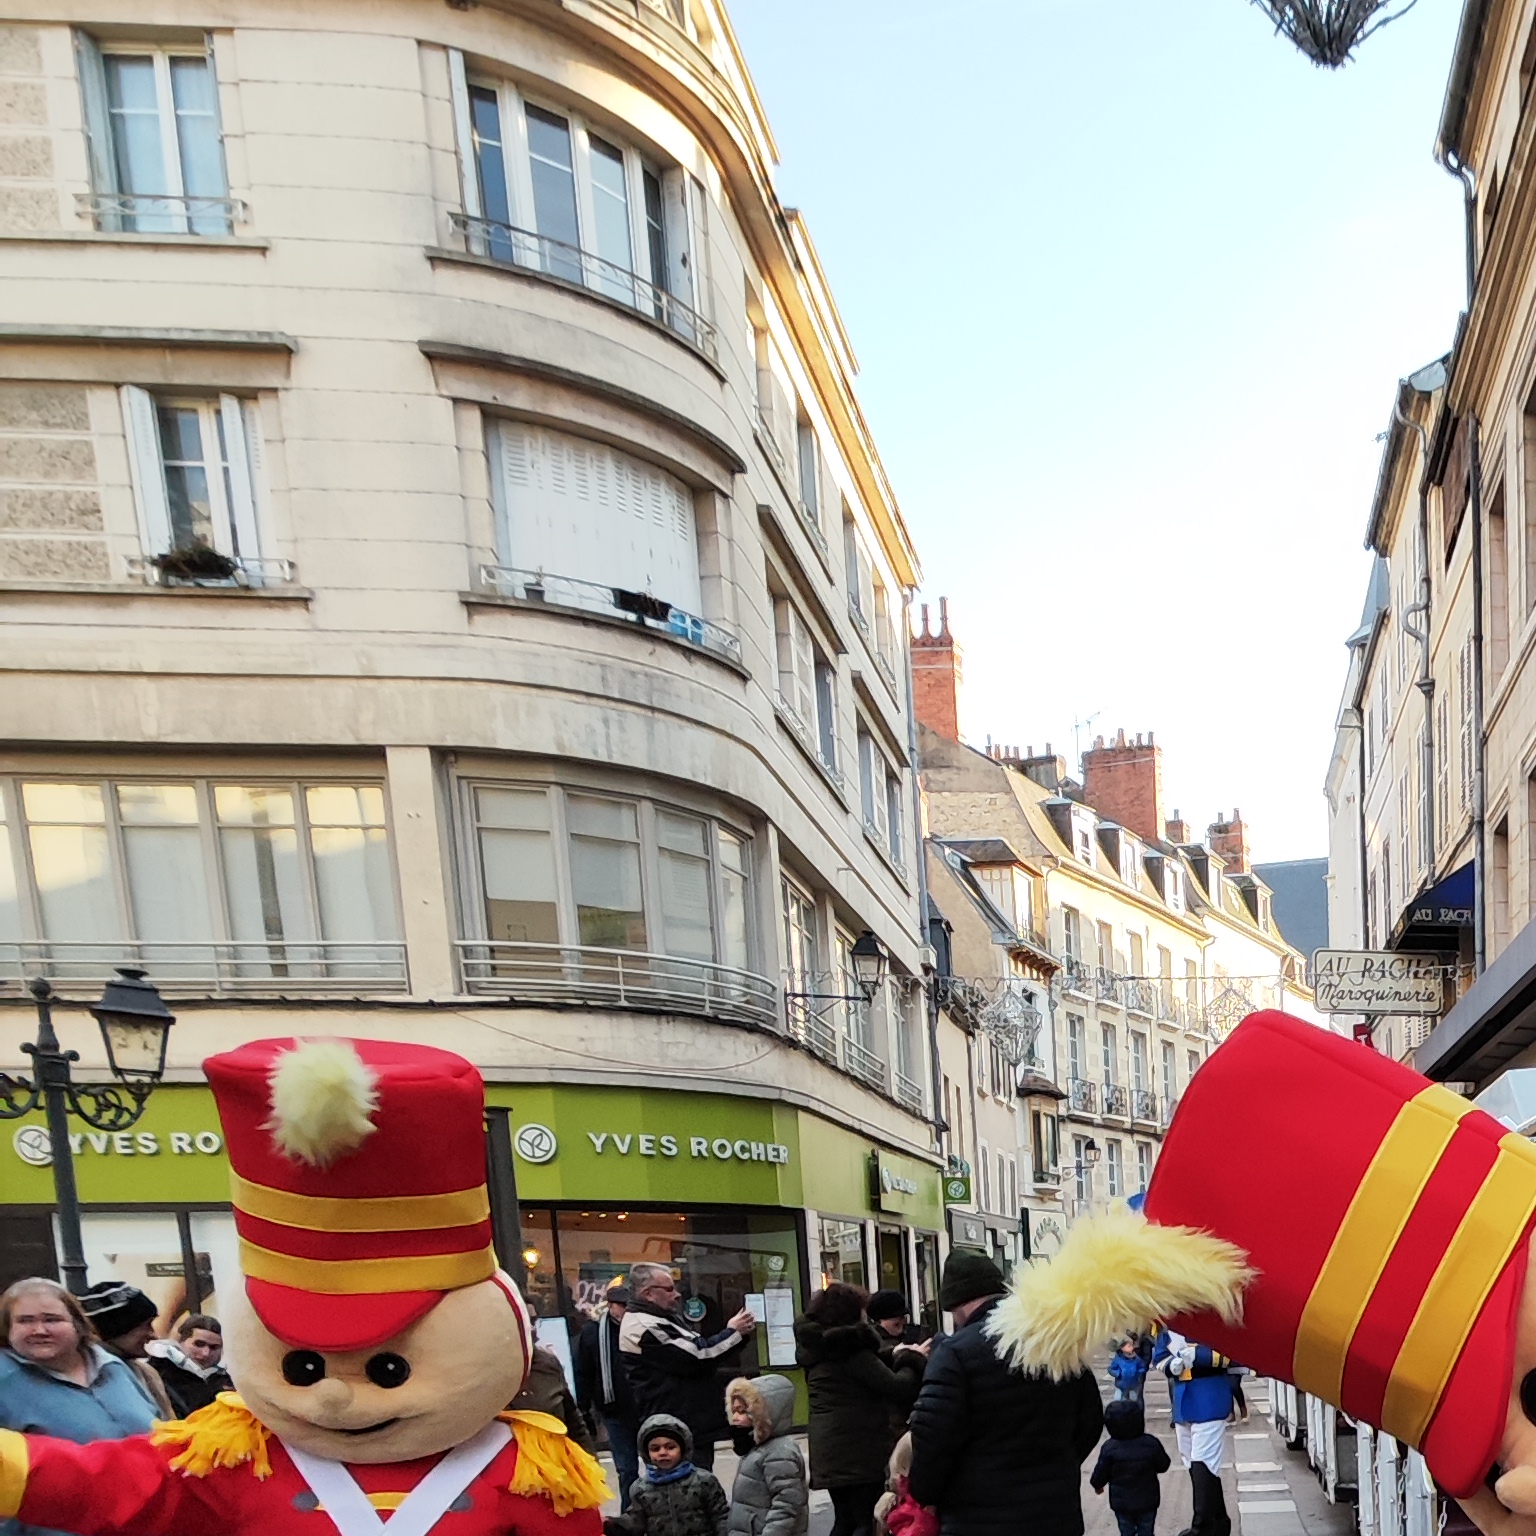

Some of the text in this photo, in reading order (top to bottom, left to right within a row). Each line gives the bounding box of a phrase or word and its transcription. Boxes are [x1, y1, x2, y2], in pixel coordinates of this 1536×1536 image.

[1412, 908, 1474, 923] AU PACH
[1320, 957, 1352, 977] AU
[1319, 982, 1436, 1009] Maroquinerie
[69, 1132, 159, 1155] YVES
[587, 1132, 789, 1164] YVES ROCHER
